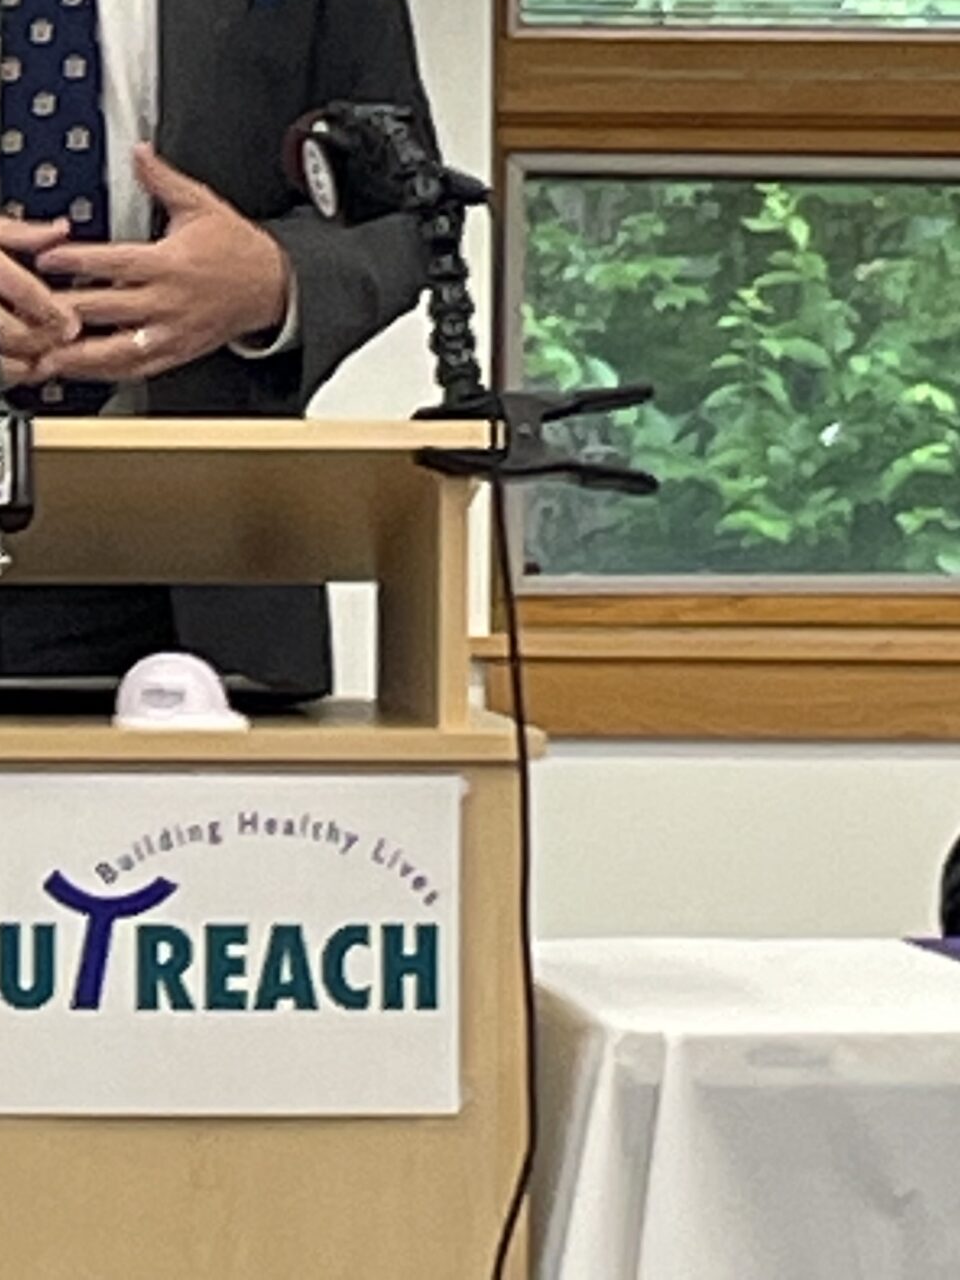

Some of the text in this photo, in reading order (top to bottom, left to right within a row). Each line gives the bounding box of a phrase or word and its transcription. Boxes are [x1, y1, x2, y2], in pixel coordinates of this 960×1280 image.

[94, 811, 438, 906] Building Healthy Lives
